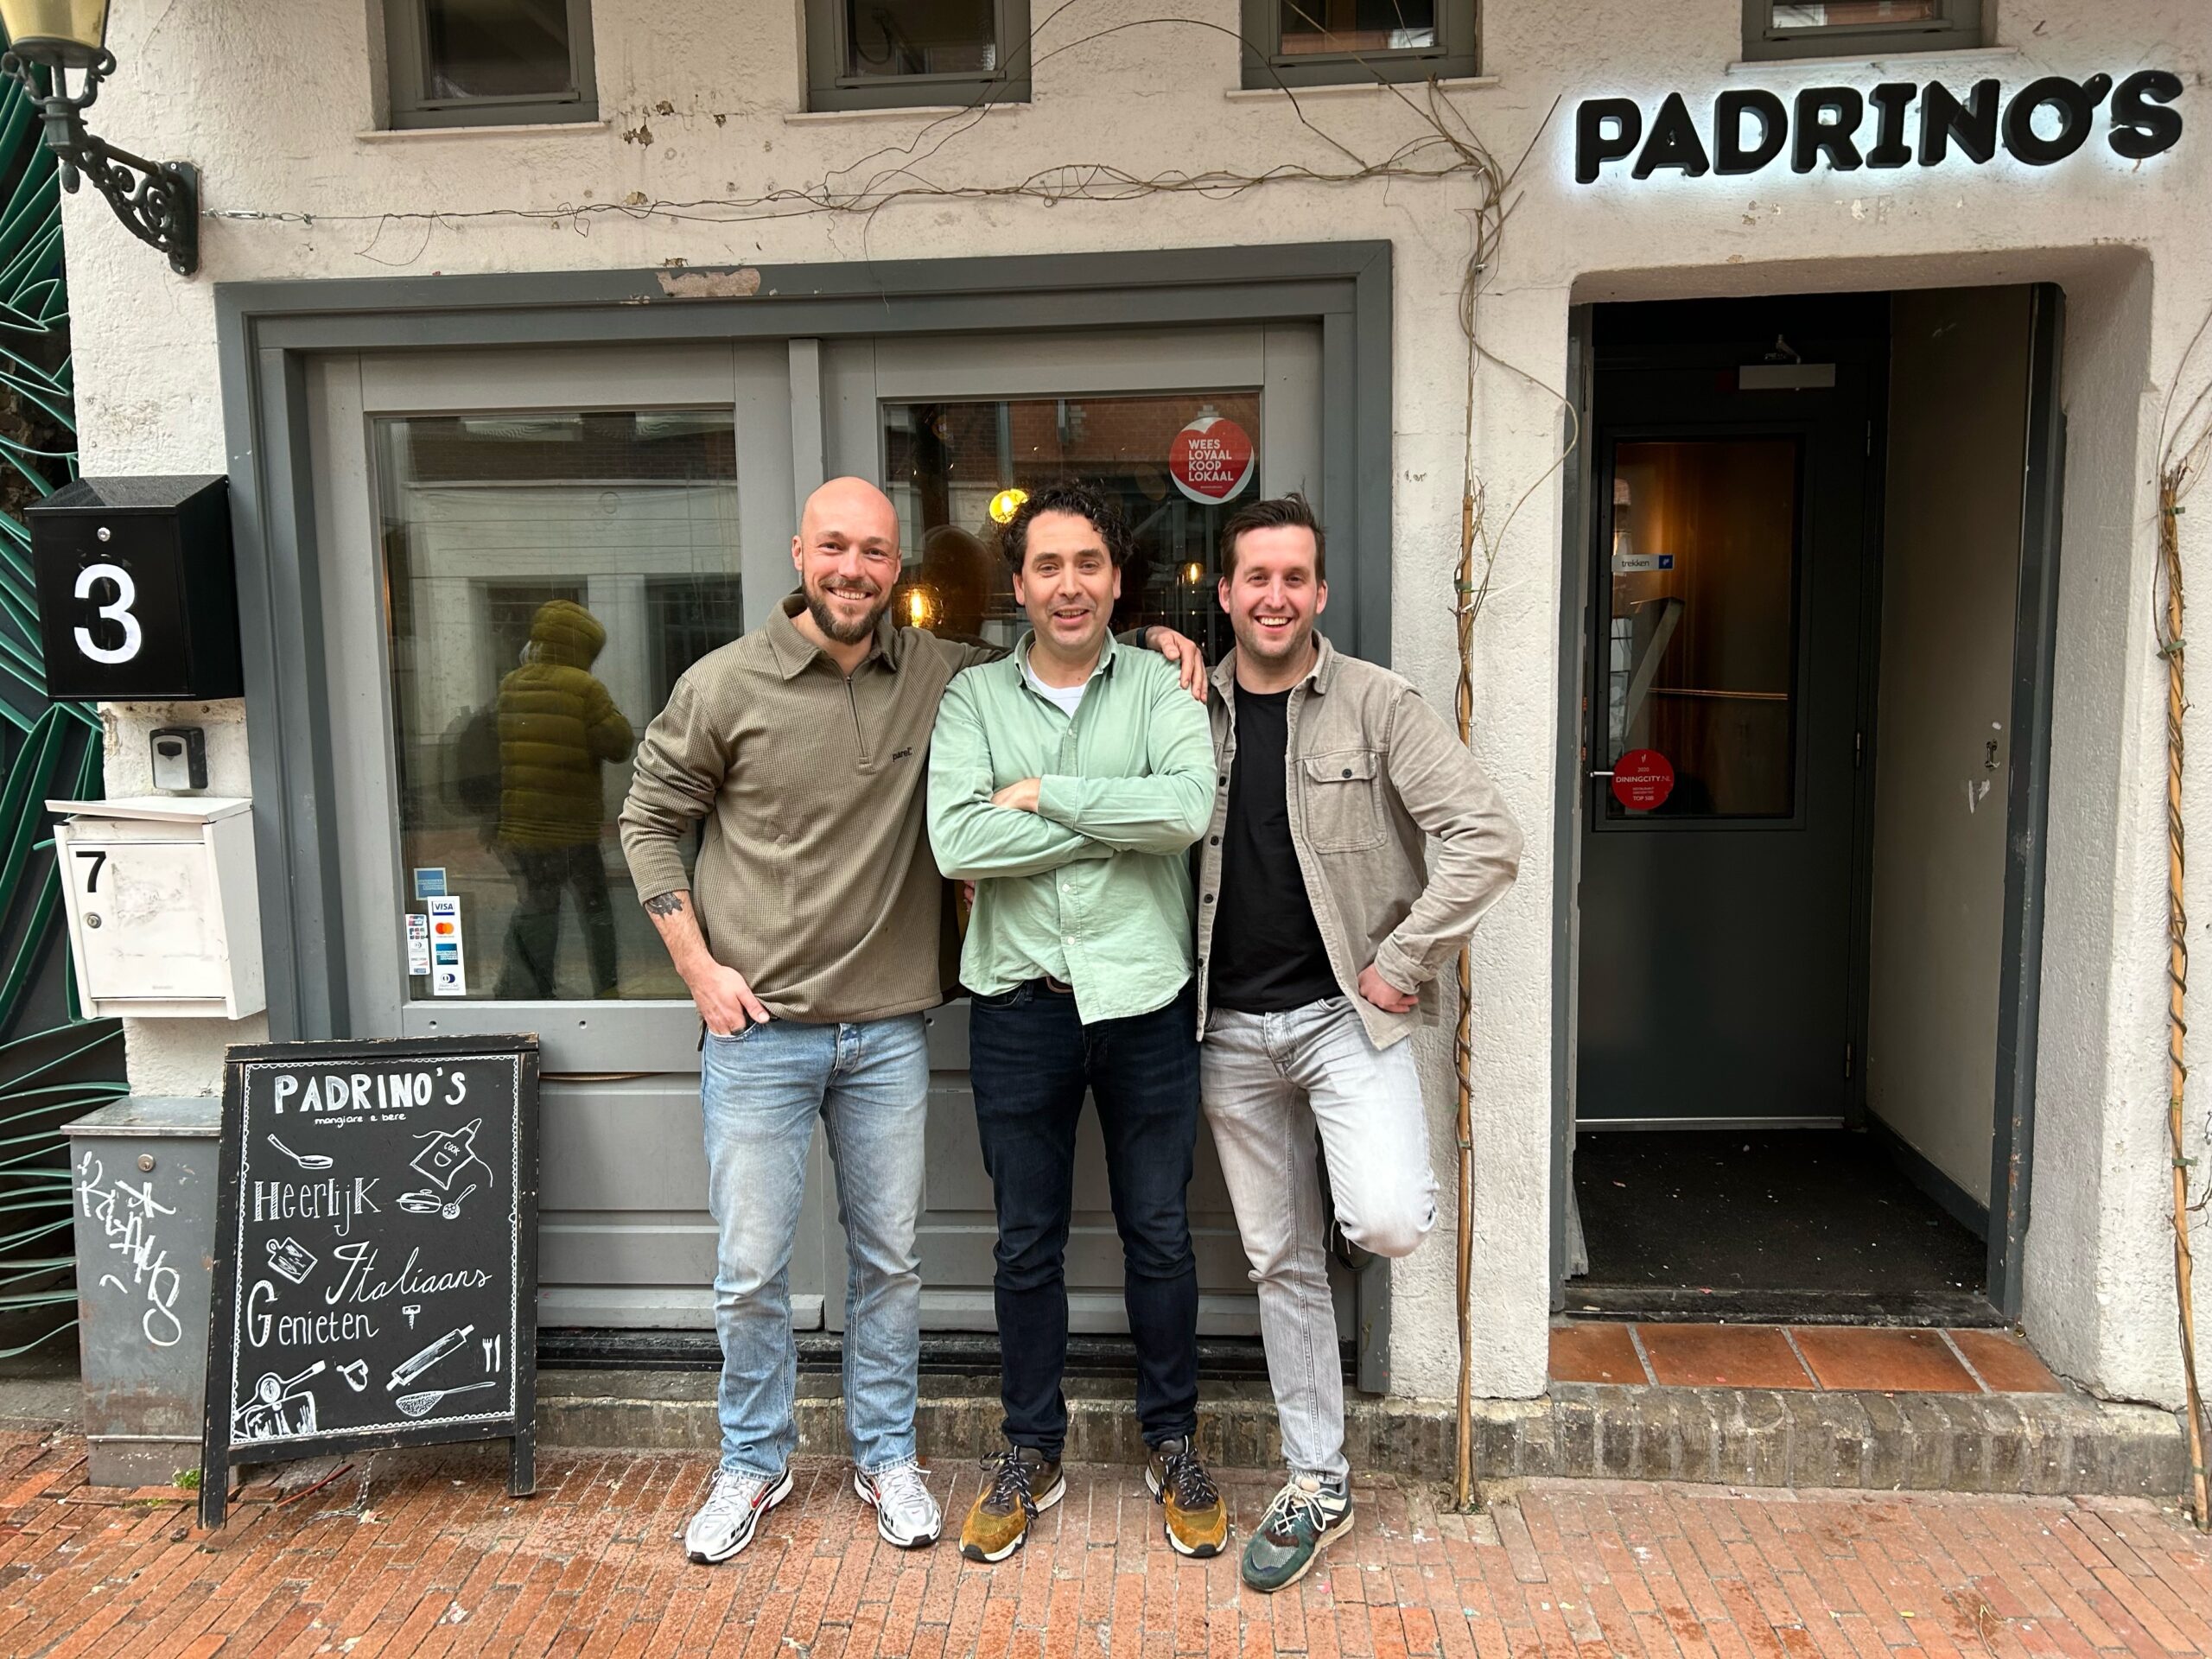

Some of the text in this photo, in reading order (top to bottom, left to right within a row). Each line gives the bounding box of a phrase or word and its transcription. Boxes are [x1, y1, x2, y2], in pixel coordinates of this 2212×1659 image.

[1575, 70, 2183, 184] PADRINO'S
[1188, 439, 1221, 449] WEES
[1188, 449, 1232, 461] LOYAAL
[1188, 461, 1222, 471] KOOP
[1188, 471, 1234, 482] LOKAAL
[73, 563, 143, 664] 3
[75, 850, 107, 893] 7
[274, 1066, 467, 1115] PADRINO'S
[314, 1116, 364, 1128] mangiare
[382, 1112, 407, 1122] bere
[325, 1241, 493, 1305] Italiaans
[247, 1280, 380, 1348] Genieten
